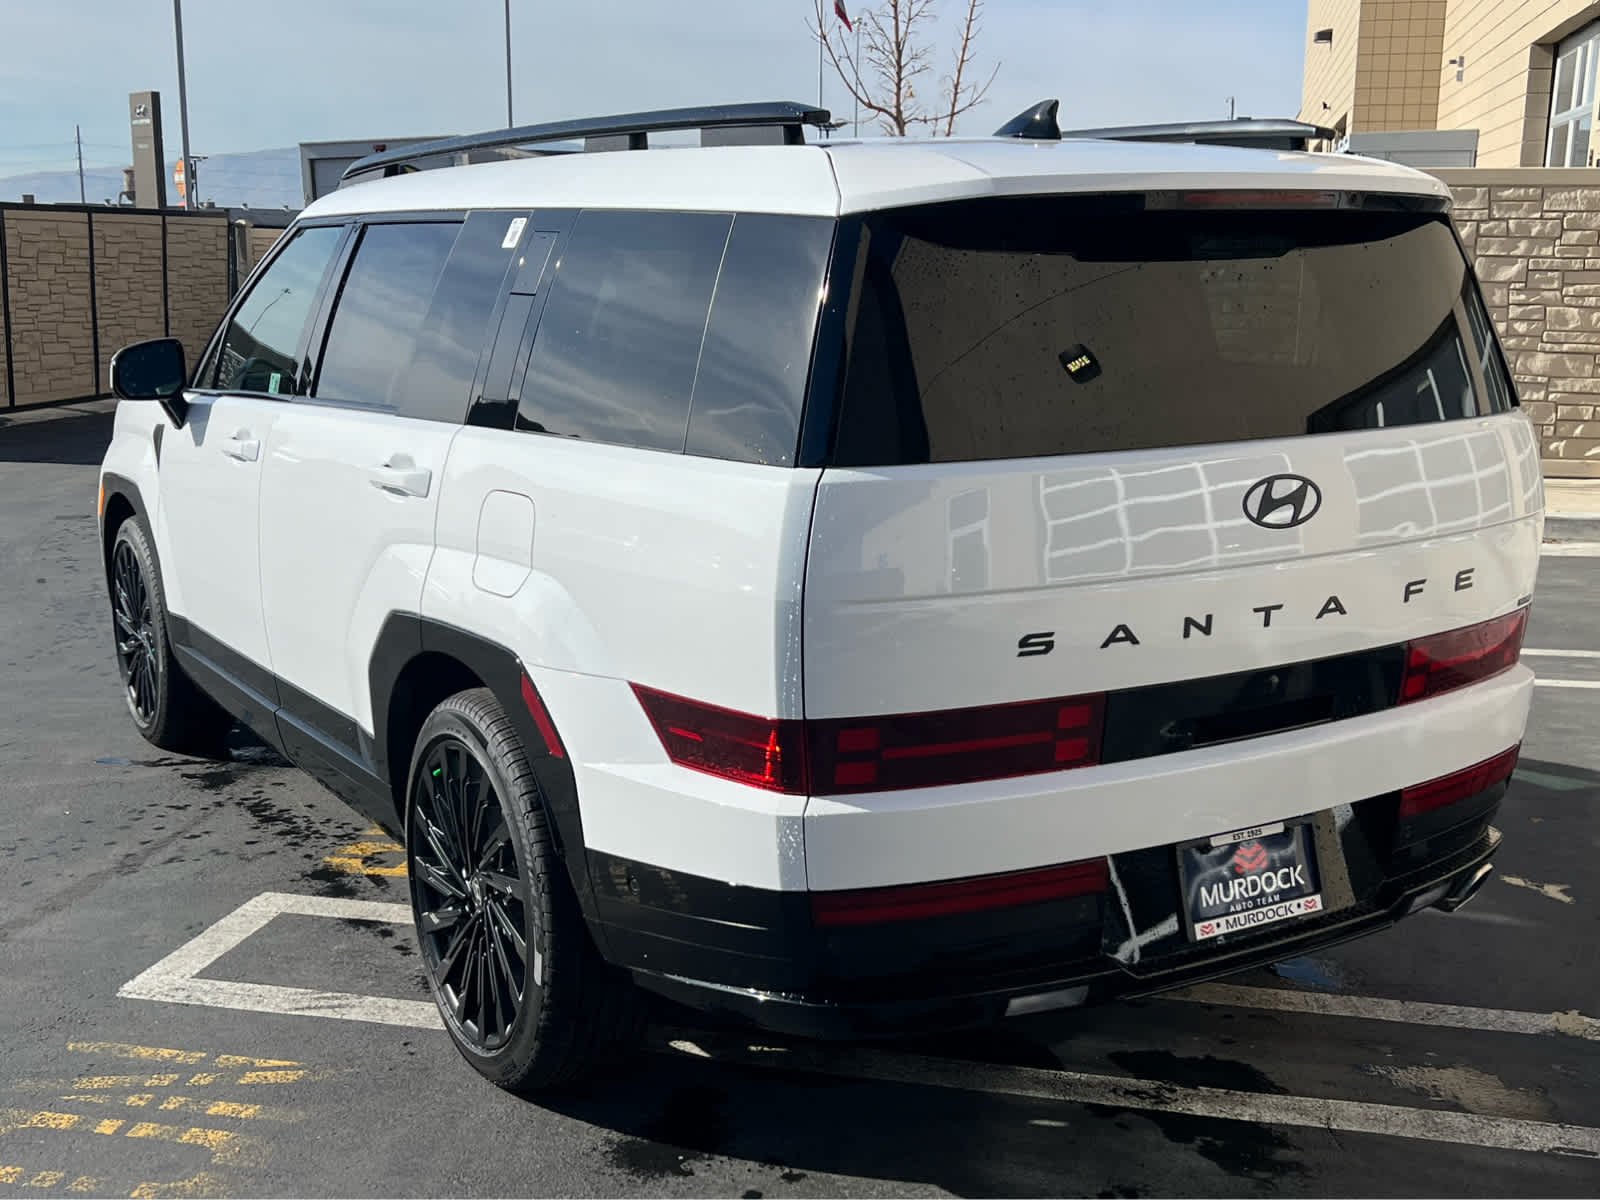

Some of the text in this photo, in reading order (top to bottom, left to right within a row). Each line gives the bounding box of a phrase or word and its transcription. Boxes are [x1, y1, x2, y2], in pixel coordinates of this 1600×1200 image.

[1016, 568, 1475, 658] SANTA FE
[1201, 864, 1305, 908] MURDOCK
[1229, 894, 1281, 913] AUTO TEAM
[1225, 903, 1295, 931] MURDOCK
